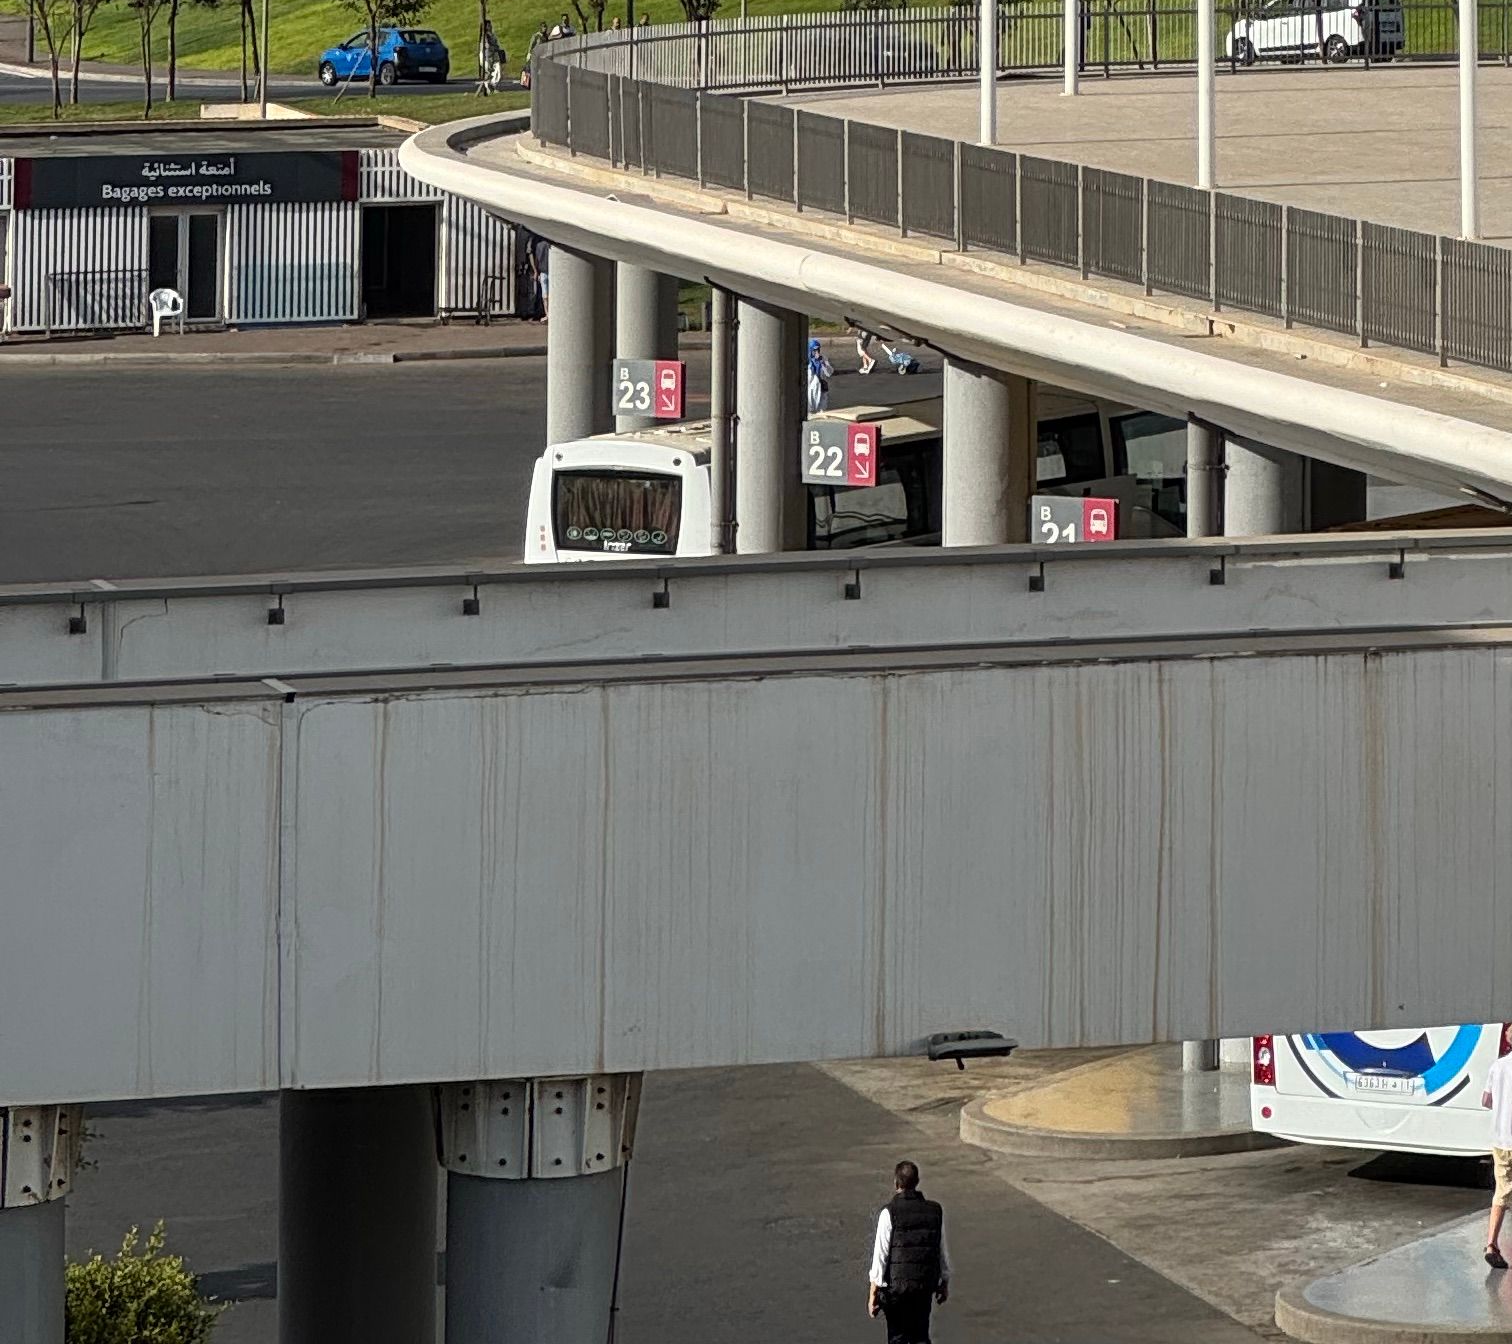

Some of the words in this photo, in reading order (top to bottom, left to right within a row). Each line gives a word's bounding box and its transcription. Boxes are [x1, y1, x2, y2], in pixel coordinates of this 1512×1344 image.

[199, 158, 235, 176] أمتعة
[102, 184, 165, 202] Bagages
[168, 180, 272, 200] exceptionnels
[620, 368, 629, 380] B
[619, 381, 650, 409] 23
[810, 431, 820, 444] B
[809, 446, 843, 477] 22
[1041, 506, 1051, 521] B
